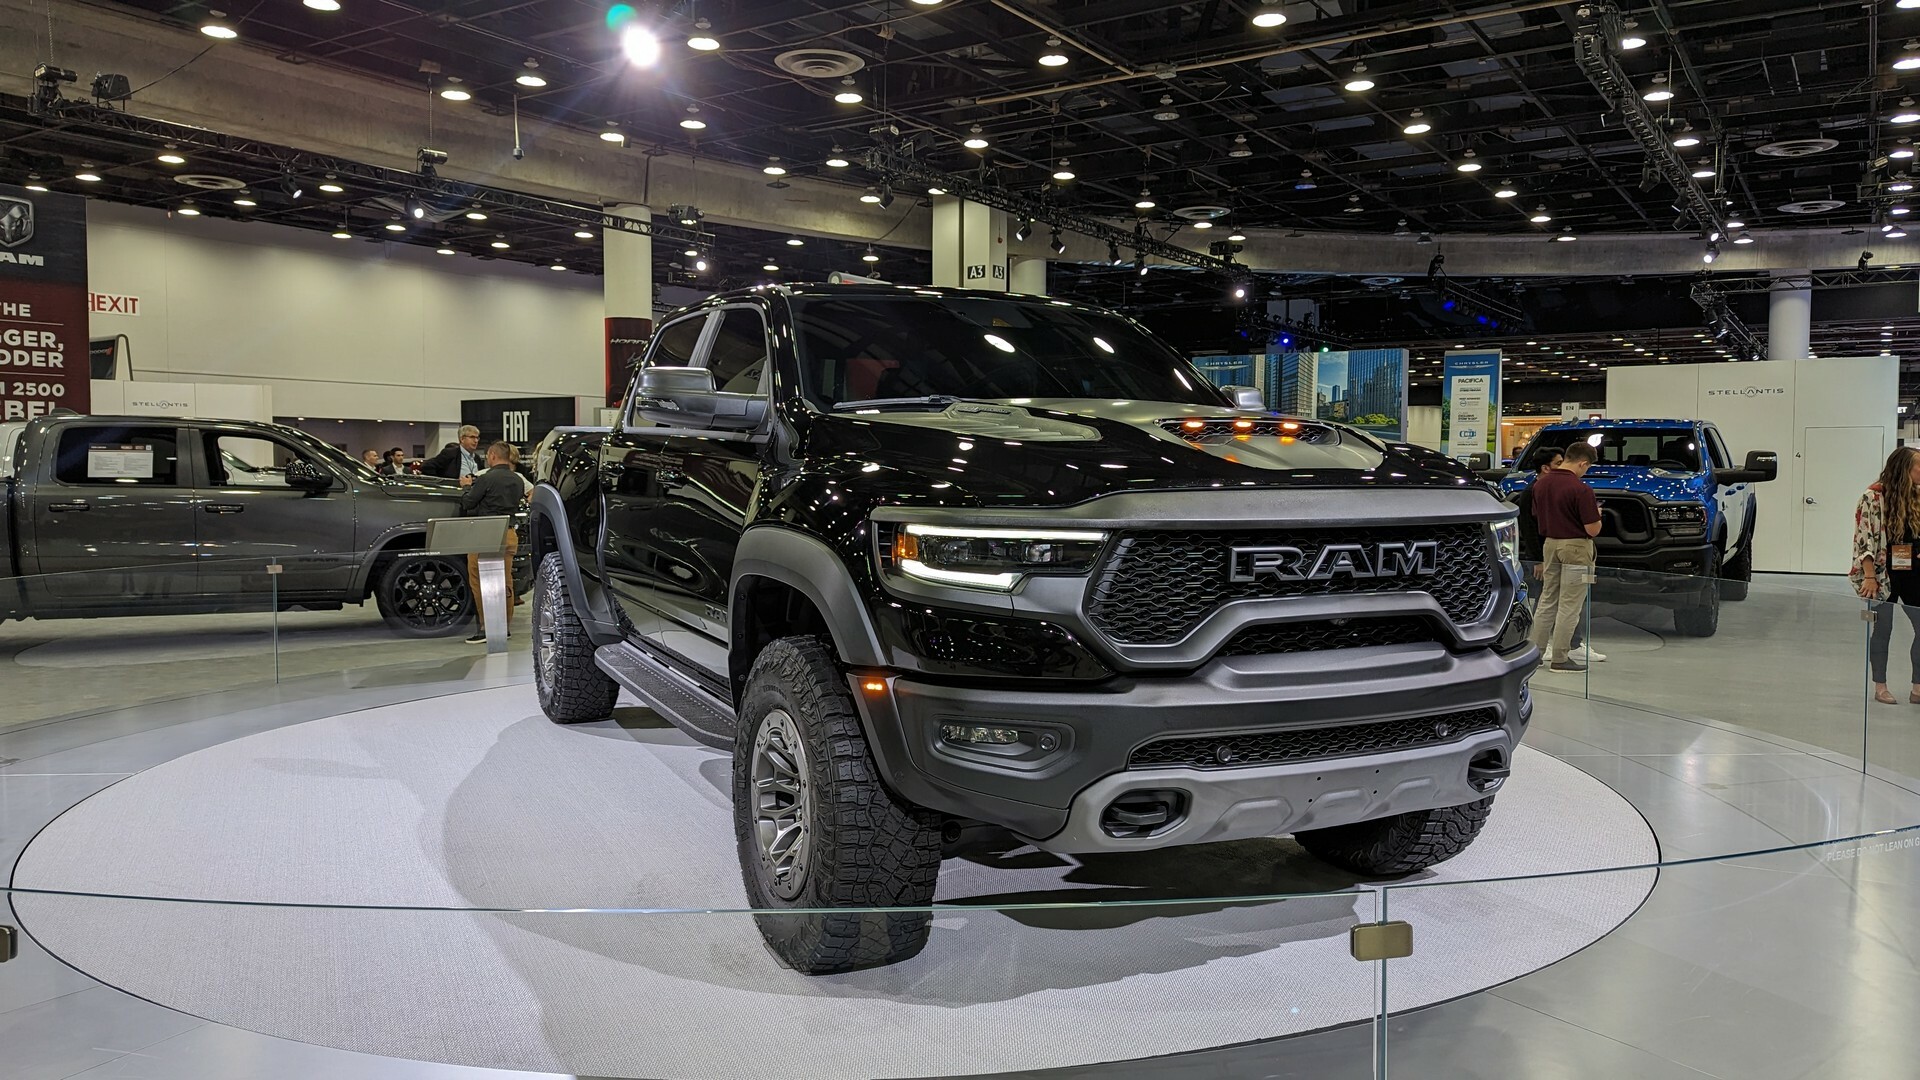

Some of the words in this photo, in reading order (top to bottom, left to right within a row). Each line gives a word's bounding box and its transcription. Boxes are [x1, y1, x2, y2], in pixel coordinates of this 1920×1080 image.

[970, 266, 983, 279] A3
[994, 267, 1003, 279] A3
[96, 294, 139, 314] EXIT
[0, 329, 64, 352] GER,
[12, 381, 65, 397] 2500
[1708, 387, 1784, 397] STELLANTIS
[132, 401, 189, 409] STELLANTIS
[503, 411, 530, 442] FIAT
[1229, 541, 1438, 583] RAM
[1827, 848, 1856, 861] PLEASE
[1885, 839, 1903, 852] LEAN
[1904, 838, 1914, 849] ON
